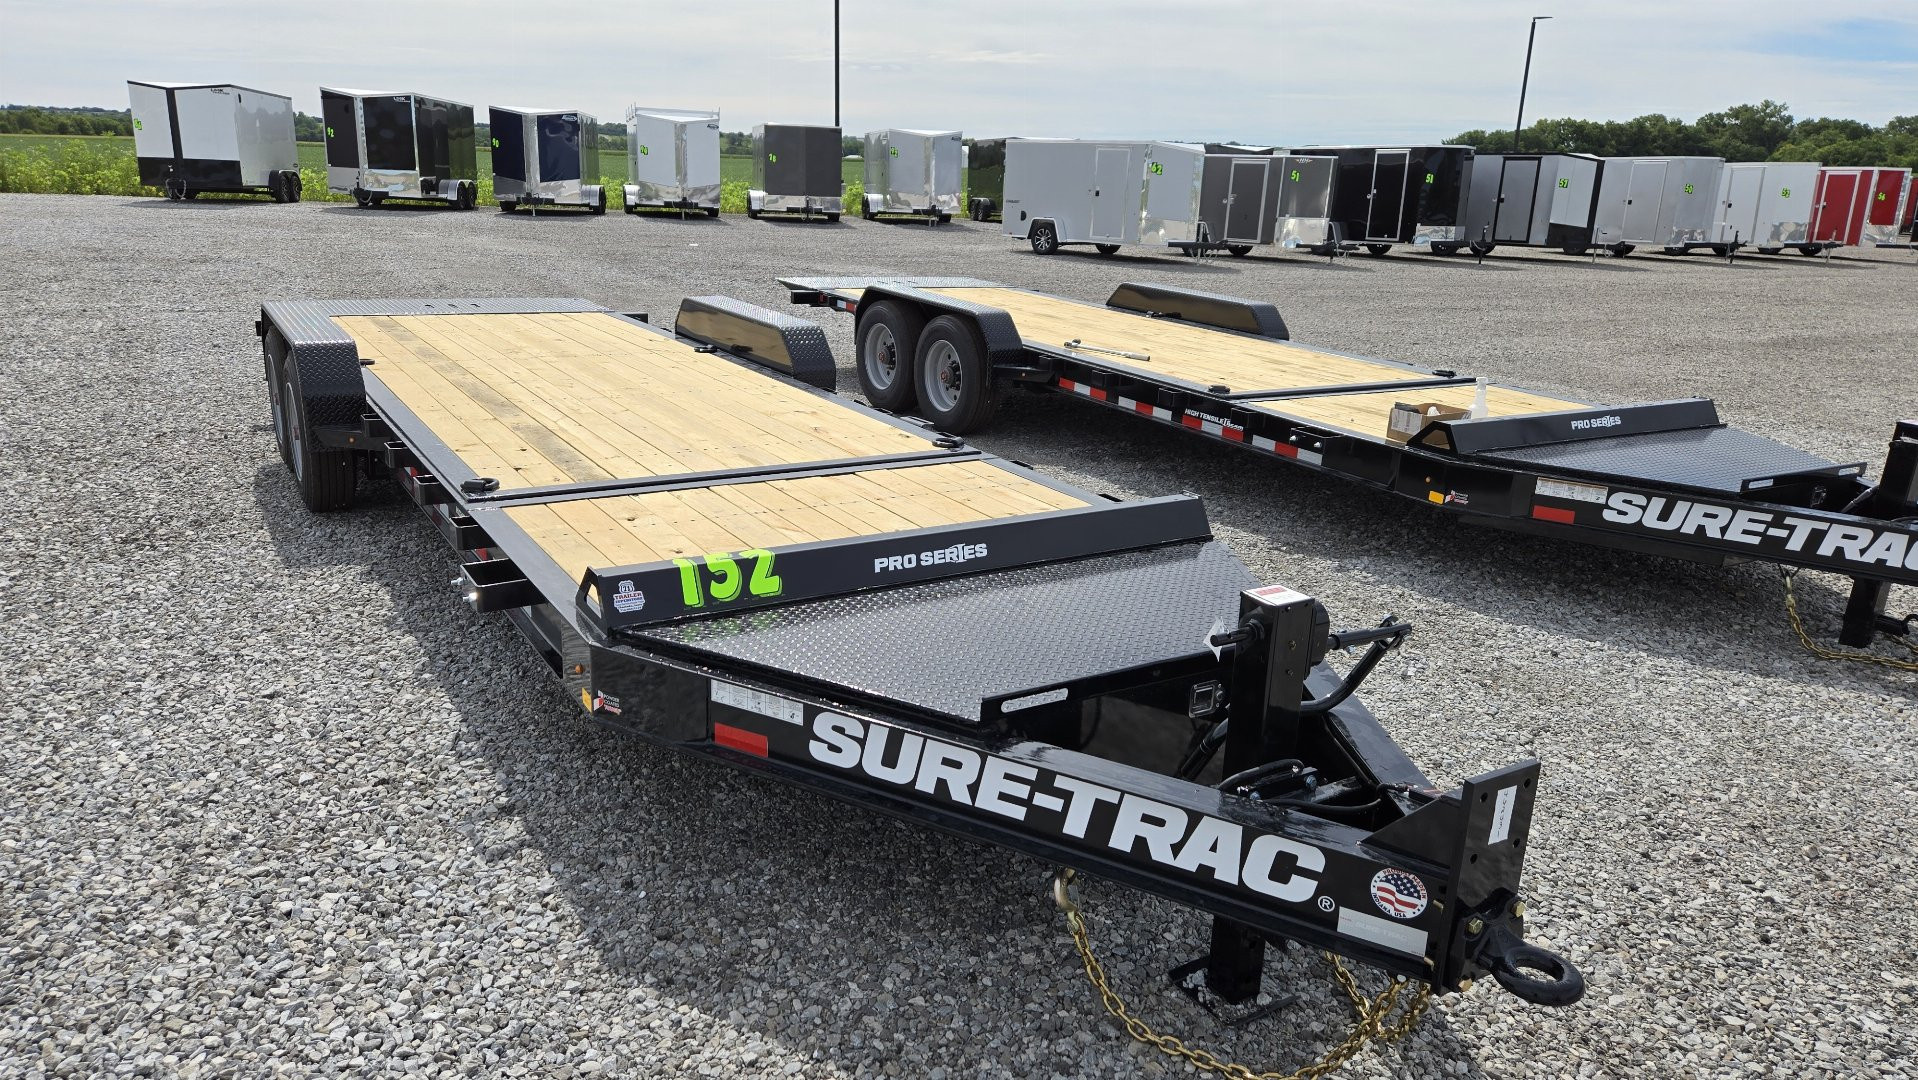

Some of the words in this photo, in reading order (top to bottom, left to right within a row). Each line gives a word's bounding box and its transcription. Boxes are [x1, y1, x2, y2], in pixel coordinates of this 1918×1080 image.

[1151, 162, 1163, 176] 62
[1290, 170, 1300, 182] 51
[1425, 173, 1434, 184] 51
[1559, 178, 1569, 188] 57
[1184, 408, 1200, 417] HIGH
[1199, 412, 1224, 425] TENSILE
[1571, 419, 1591, 430] PRO
[1590, 414, 1622, 428] SERIES
[874, 553, 917, 573] PRO
[920, 543, 988, 566] SERIES
[673, 549, 783, 608] 152
[614, 592, 642, 600] TRAILER
[603, 693, 620, 703] POWDER
[603, 699, 620, 708] COATED
[808, 711, 1326, 903] SURE-TRAC
